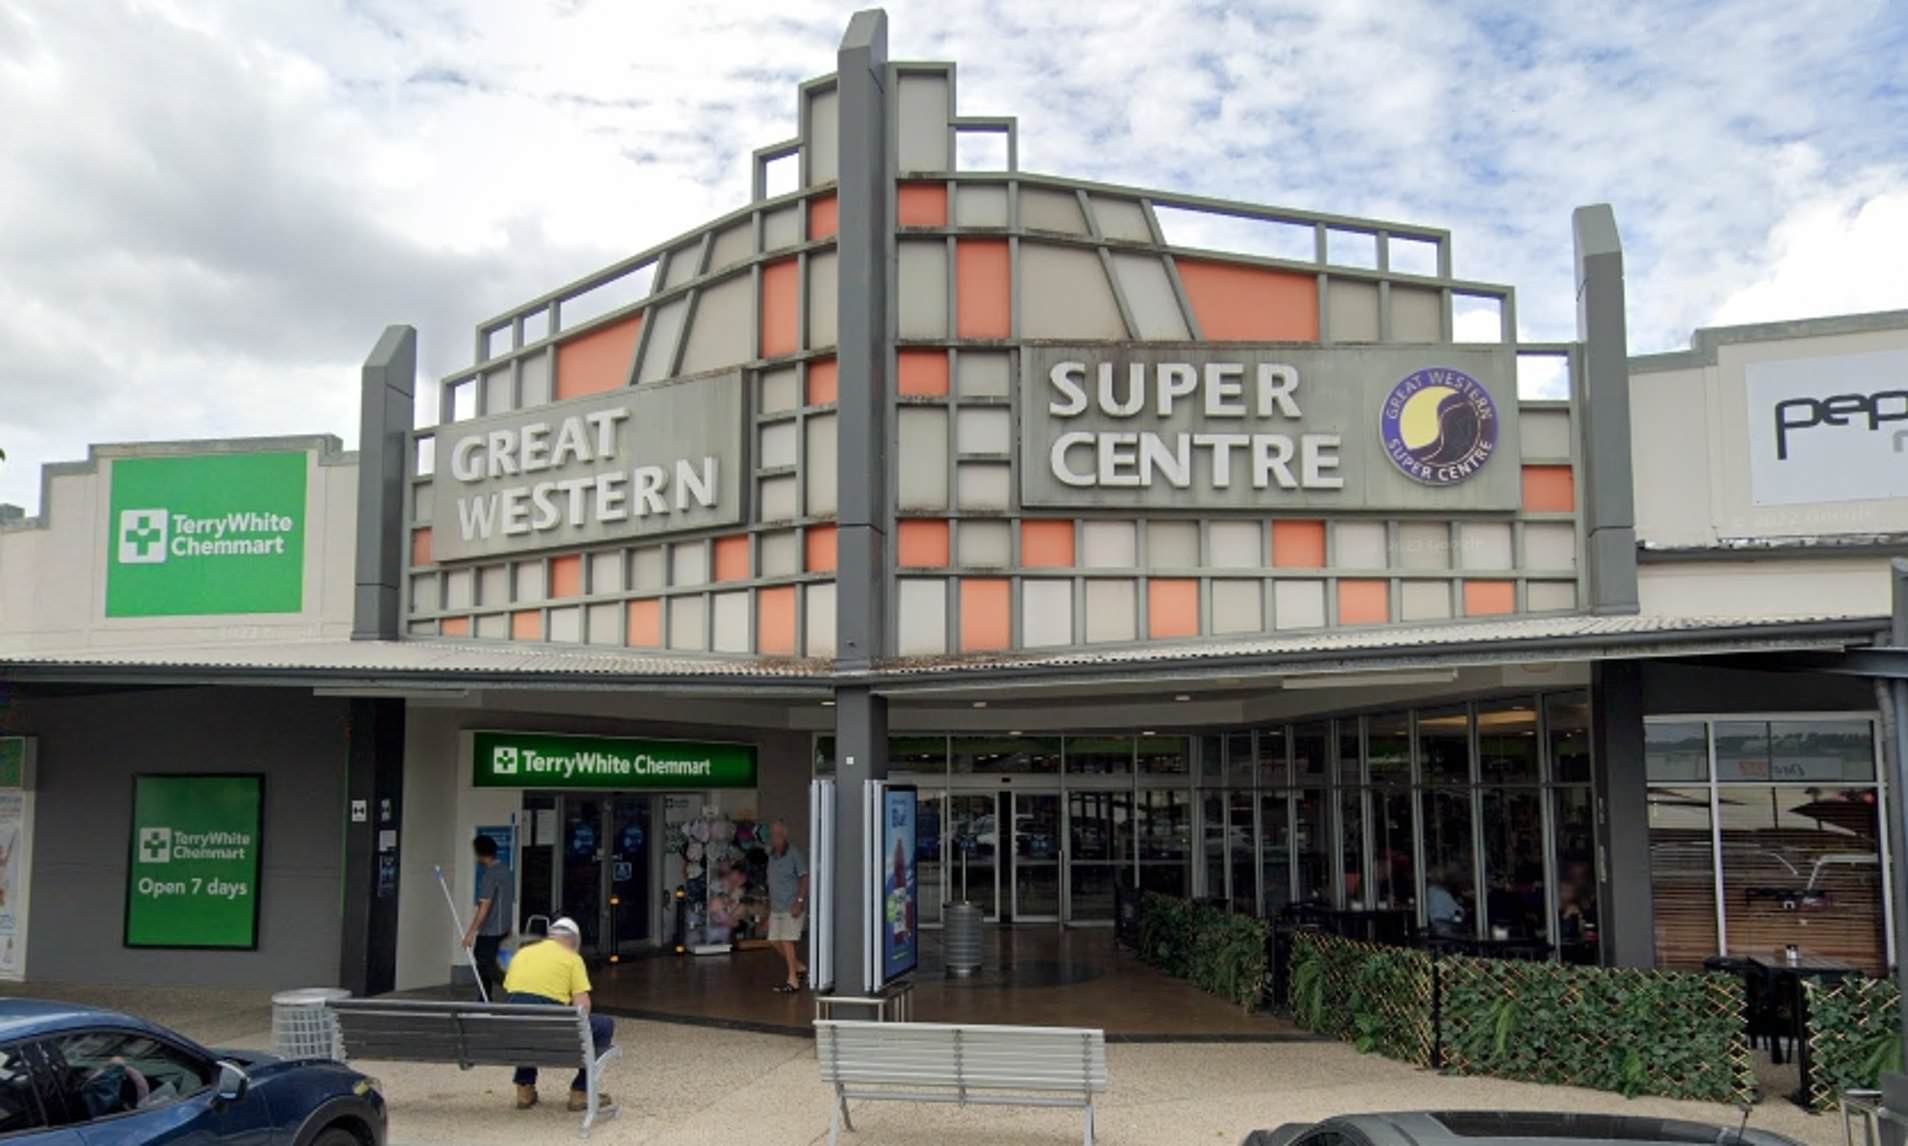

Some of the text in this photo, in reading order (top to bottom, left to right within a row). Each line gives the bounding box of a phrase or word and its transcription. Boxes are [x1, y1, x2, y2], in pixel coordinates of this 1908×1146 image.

[1049, 361, 1302, 418] SUPER
[1386, 371, 1493, 420] GREAT WESTERN
[452, 406, 631, 482] GREAT
[1775, 390, 1908, 460] pep
[1050, 431, 1344, 488] CENTRE
[1388, 438, 1493, 481] SUPER CENTRE
[457, 455, 720, 542] WESTERN
[171, 535, 284, 556] Chemmart
[172, 511, 293, 538] TerryWhite
[522, 750, 711, 778] TerryWhite Chemmart
[173, 830, 251, 847] TerryWhite
[173, 844, 246, 860] Chemmart
[138, 876, 248, 900] Open 7 days
